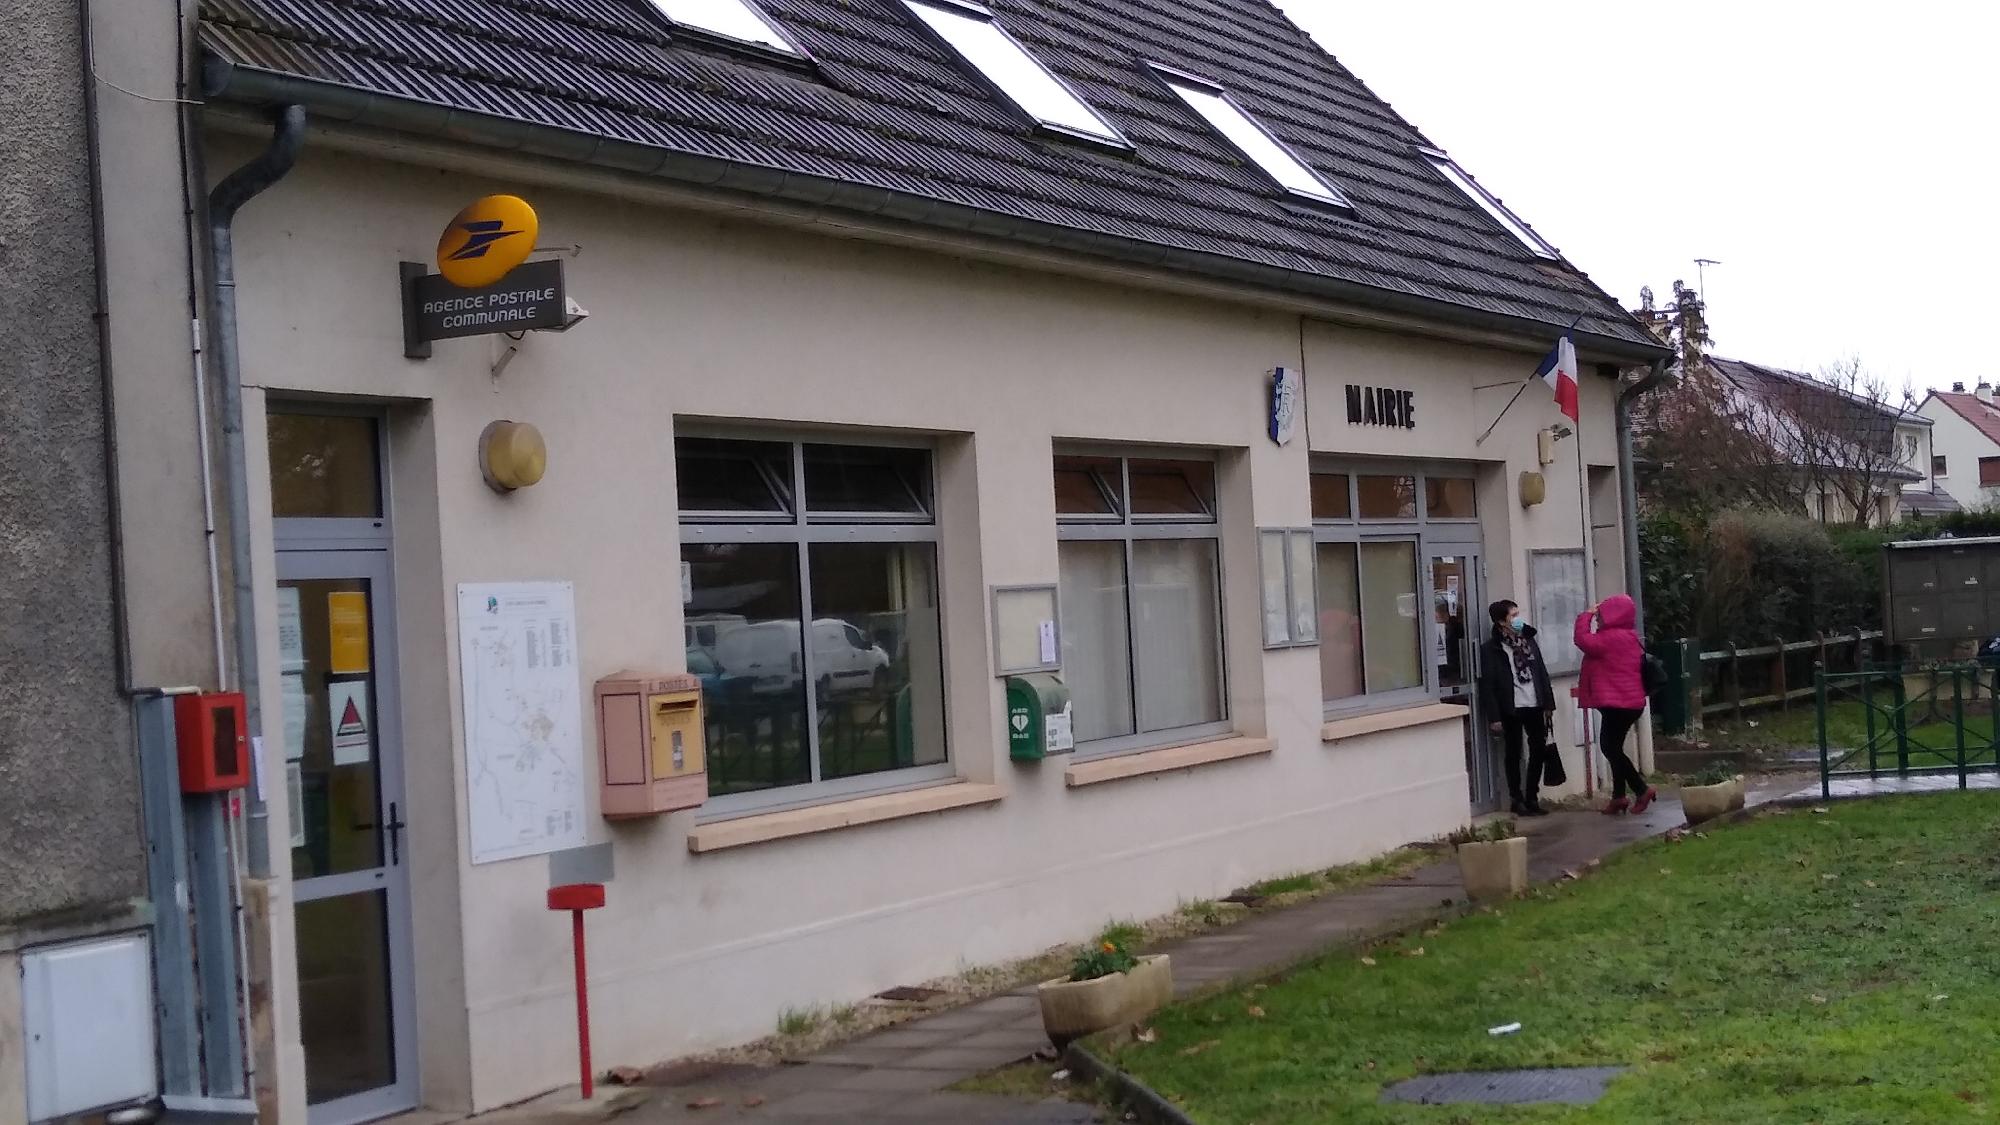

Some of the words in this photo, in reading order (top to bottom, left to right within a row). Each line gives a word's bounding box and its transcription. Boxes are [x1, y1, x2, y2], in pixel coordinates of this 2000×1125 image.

[424, 296, 484, 313] AGENCE
[489, 288, 555, 306] POSTALE
[442, 307, 536, 328] COMMUNALE
[1345, 384, 1416, 429] MAIRIE
